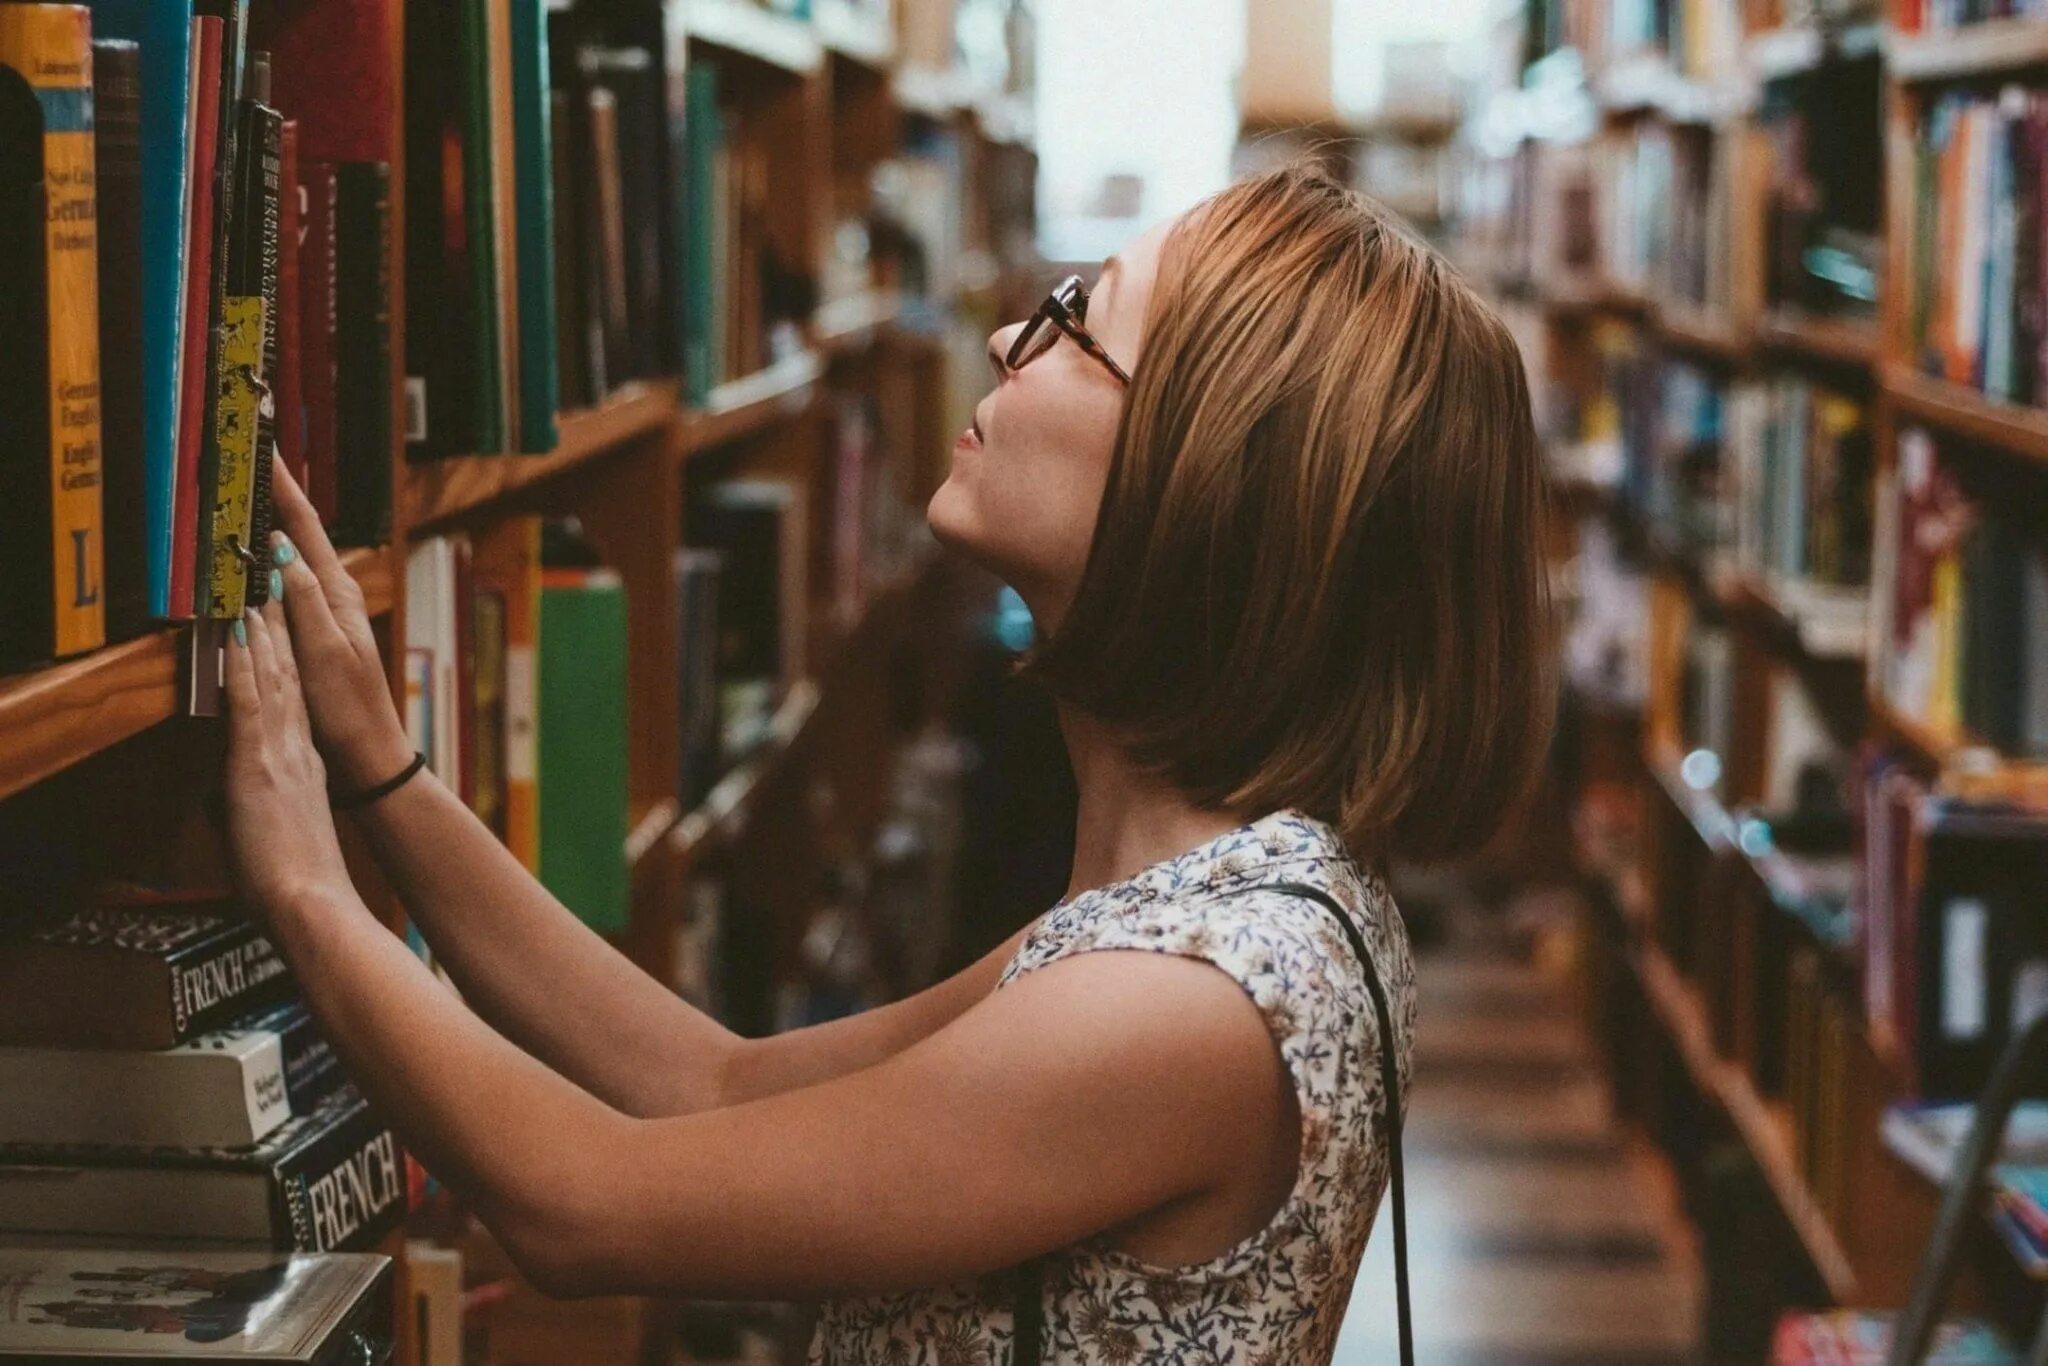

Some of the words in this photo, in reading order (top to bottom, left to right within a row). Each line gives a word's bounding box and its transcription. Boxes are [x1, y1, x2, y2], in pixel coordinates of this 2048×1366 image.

[70, 528, 98, 607] L
[183, 947, 246, 1016] FRENCH
[308, 1130, 400, 1254] FRENCH
